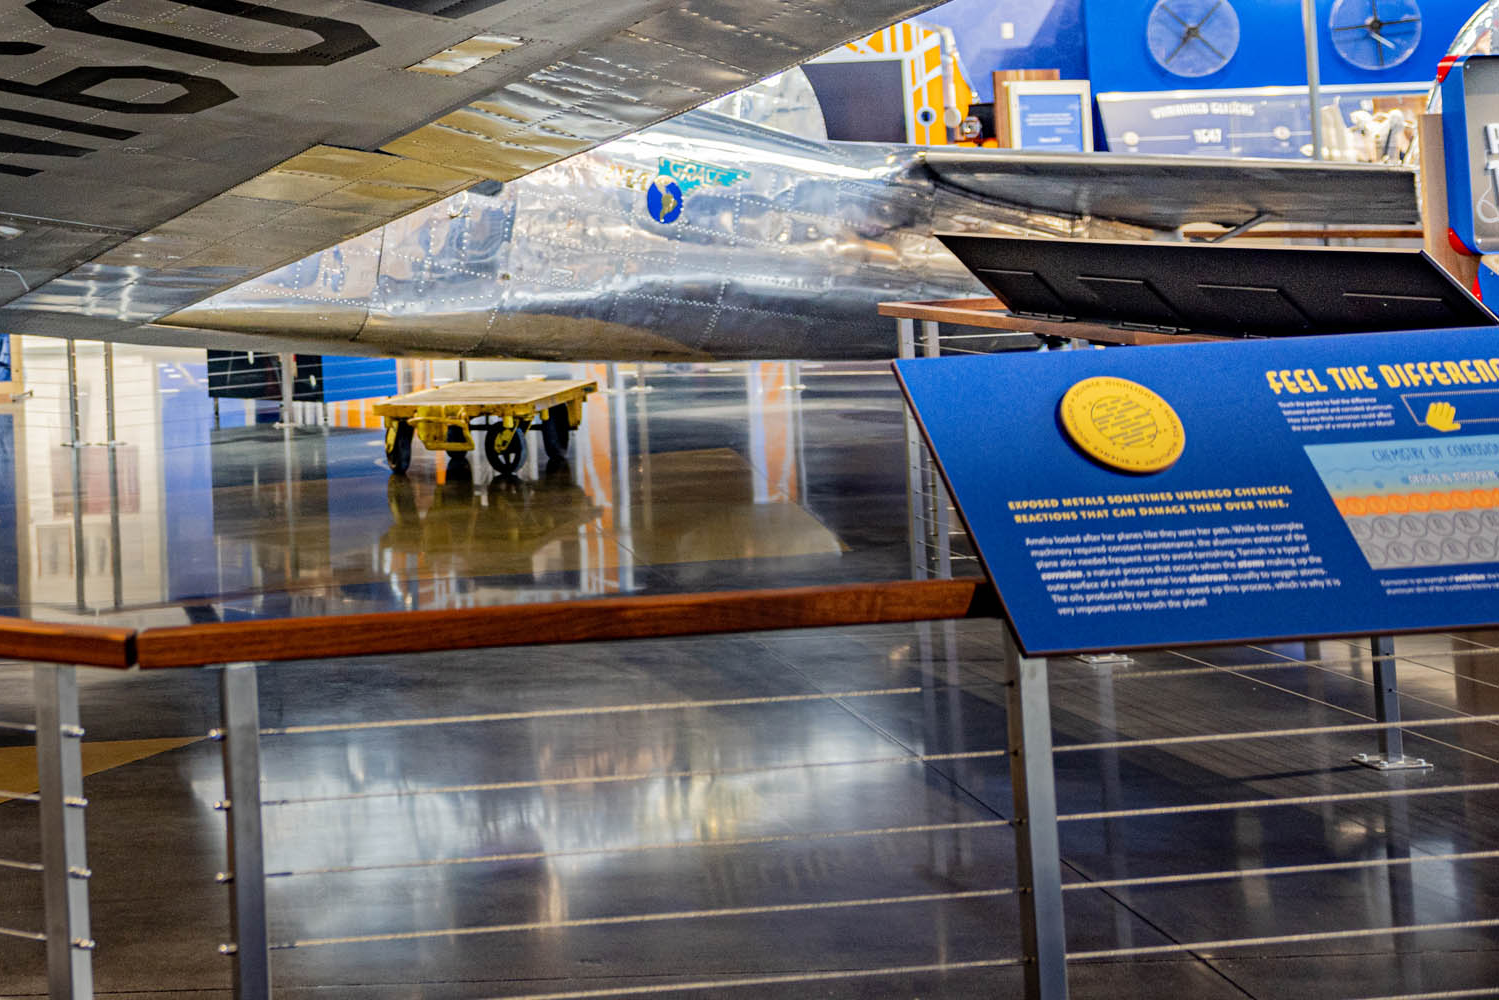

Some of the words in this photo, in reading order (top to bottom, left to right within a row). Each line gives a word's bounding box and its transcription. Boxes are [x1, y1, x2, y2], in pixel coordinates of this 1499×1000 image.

[1265, 368, 1329, 395] FEEL
[1326, 365, 1379, 391] THE
[1008, 499, 1059, 510] EXPOSED
[1062, 496, 1105, 507] METALS
[1107, 493, 1173, 504] SOMETIMES
[1176, 489, 1232, 500] UNDERGO
[1234, 486, 1291, 497] CHEMICAL
[1014, 512, 1078, 523] REACTIONS
[1080, 510, 1109, 519] THAT
[1112, 508, 1136, 518] CAN
[1139, 505, 1187, 516] DAMAGE
[1189, 503, 1222, 513] THEM
[1225, 501, 1255, 511] OVER
[1257, 499, 1288, 509] TIME.
